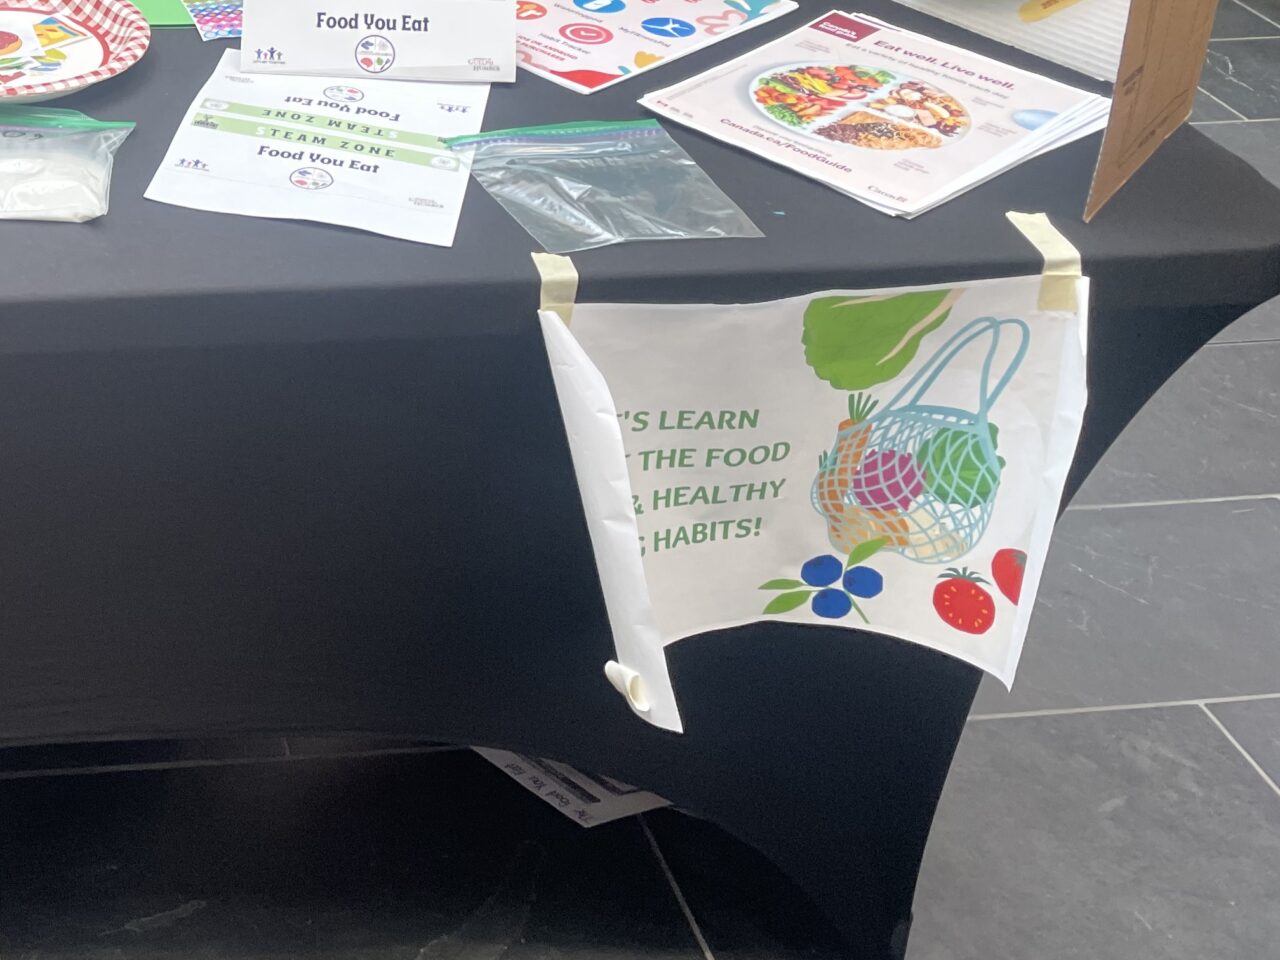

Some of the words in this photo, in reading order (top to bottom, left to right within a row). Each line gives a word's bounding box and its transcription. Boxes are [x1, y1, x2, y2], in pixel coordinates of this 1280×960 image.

[316, 12, 359, 29] Food
[364, 14, 397, 31] You
[402, 15, 430, 32] Eat
[873, 40, 902, 52] Eat
[903, 49, 939, 64] well.
[940, 62, 978, 77] Live
[978, 74, 1016, 90] well.
[284, 95, 314, 107] Eat
[316, 100, 351, 114] You
[262, 109, 314, 123] ZONE
[356, 107, 401, 122] Food
[327, 119, 398, 140] STEAM
[255, 126, 326, 146] STEAM
[340, 140, 397, 158] ZONE
[257, 145, 304, 161] Food
[308, 152, 345, 167] You
[349, 159, 380, 174] Eat
[658, 408, 760, 432] LEARN
[639, 446, 700, 473] THE
[704, 441, 792, 467] FOOD
[651, 477, 787, 508] HEALTHY
[651, 516, 763, 553] HABITS!
